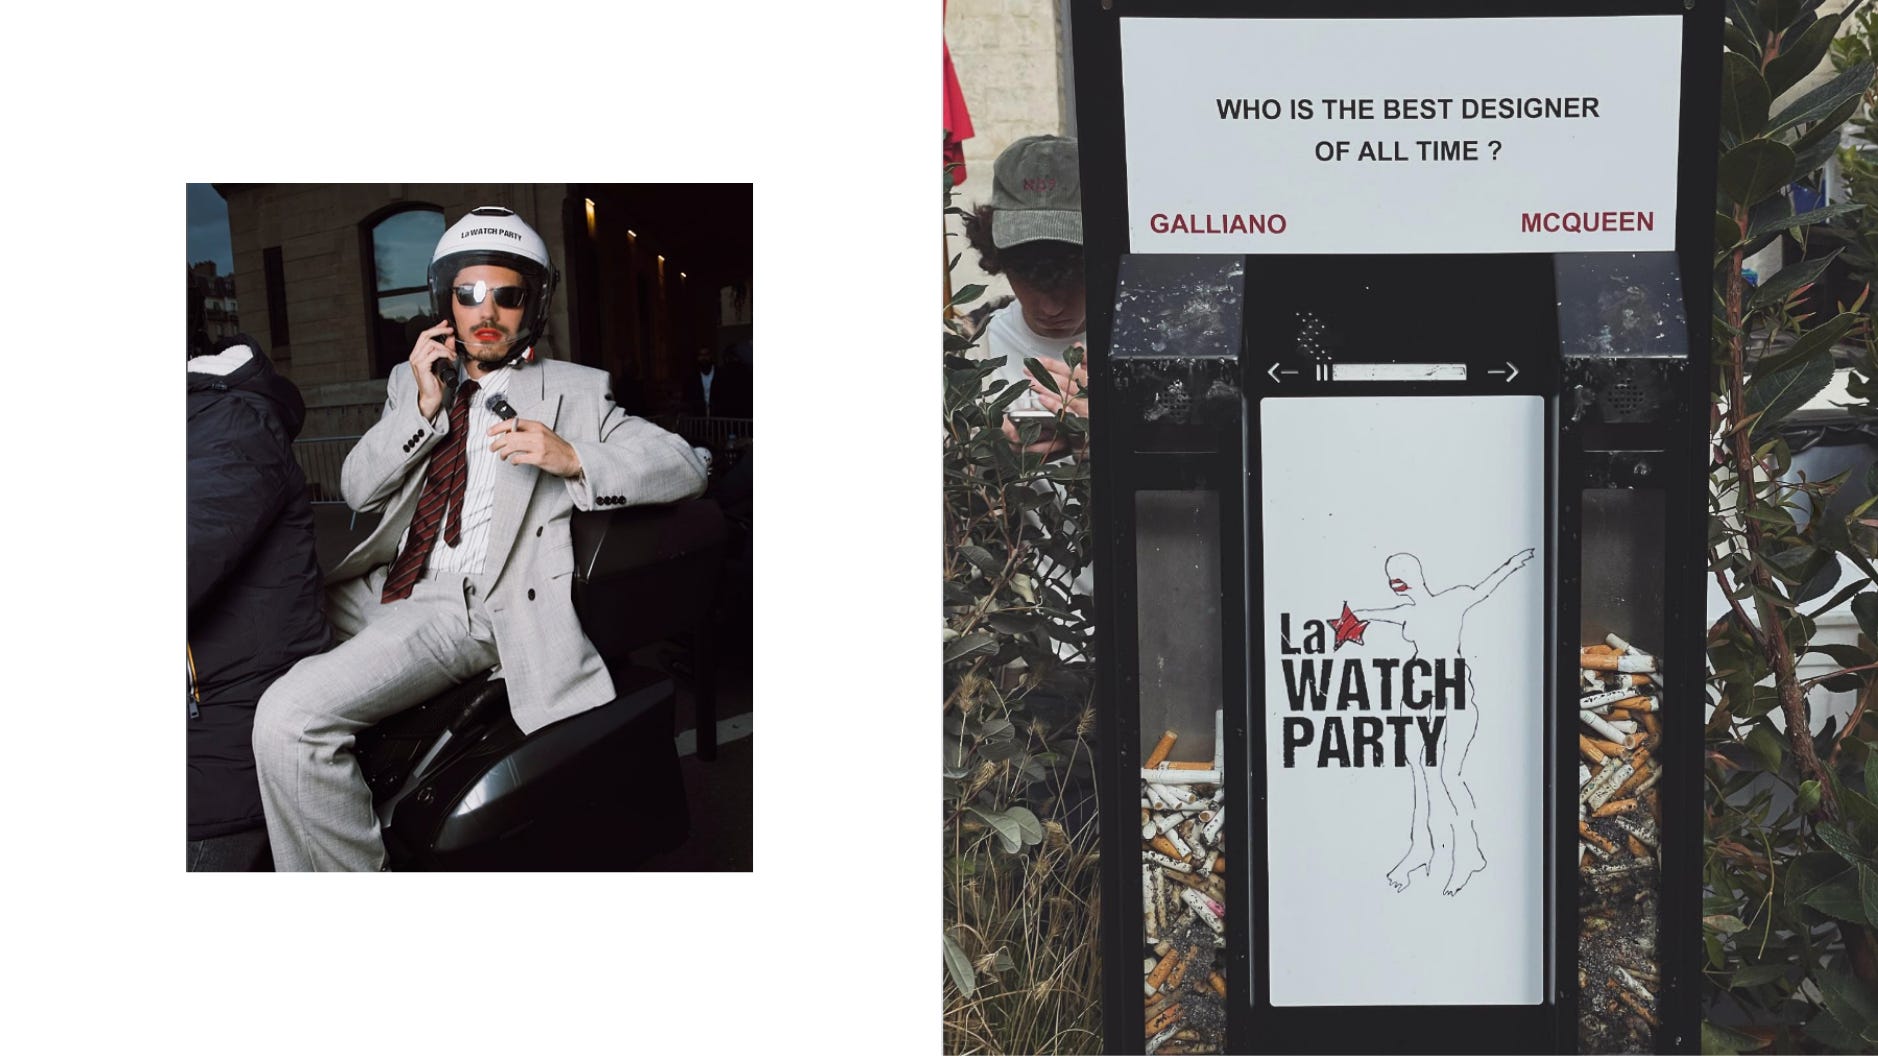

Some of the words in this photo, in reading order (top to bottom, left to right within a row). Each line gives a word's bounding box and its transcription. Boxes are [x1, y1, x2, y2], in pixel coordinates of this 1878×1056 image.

[1216, 98, 1282, 120] WHO
[1290, 98, 1314, 120] IS
[1321, 99, 1375, 120] THE
[1383, 98, 1454, 120] BEST
[1462, 97, 1600, 119] DESIGNER
[1315, 140, 1351, 162] OF
[1357, 140, 1409, 162] ALL
[1415, 140, 1479, 162] TIME
[1487, 140, 1502, 162] ?
[470, 227, 498, 236] WATCH
[498, 228, 522, 241] PARTY
[1150, 213, 1287, 235] GALLIANO
[1521, 211, 1654, 235] MCQUEEN
[1280, 612, 1326, 655] La
[1281, 657, 1467, 712] WATCH
[1282, 715, 1448, 769] PARTY
